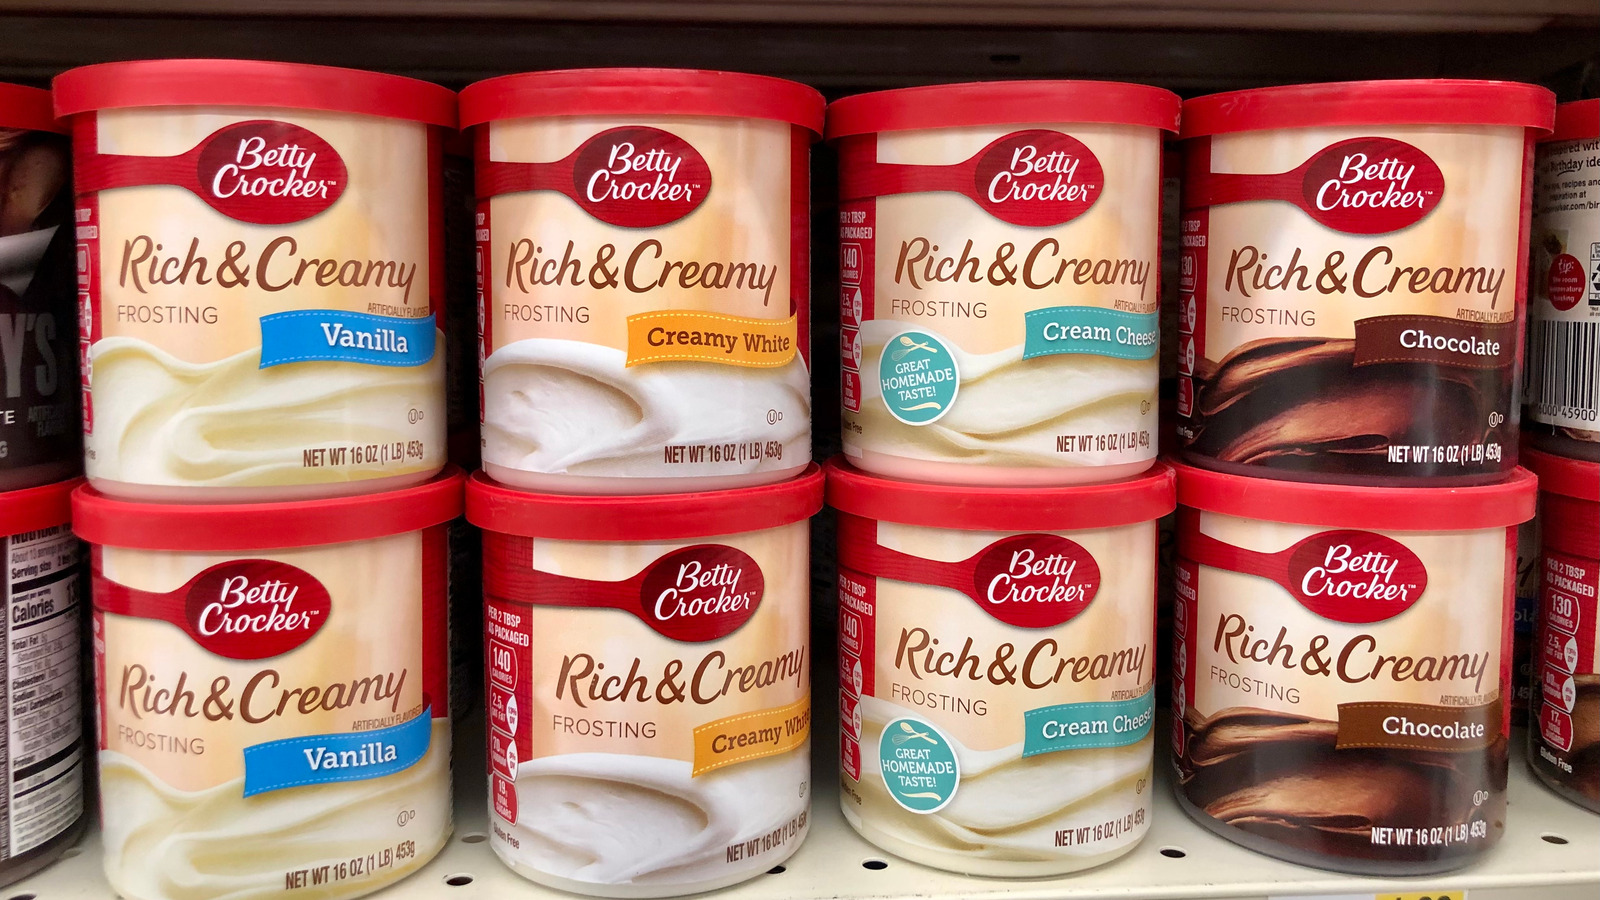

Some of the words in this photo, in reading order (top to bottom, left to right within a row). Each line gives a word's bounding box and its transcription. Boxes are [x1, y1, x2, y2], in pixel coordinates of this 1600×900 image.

[236, 136, 316, 178] Betty
[608, 142, 681, 182] Betty
[1010, 145, 1079, 183] Betty
[1339, 153, 1415, 190] Betty
[851, 211, 866, 224] TBSP
[845, 228, 872, 239] PACKAGED
[843, 249, 857, 268] 140
[1558, 259, 1574, 274] tip:
[118, 305, 218, 323] FROSTING
[367, 302, 406, 317] ARTIFICIALLY
[504, 304, 590, 323] FROSTING
[891, 299, 987, 318] FROSTING
[1221, 306, 1315, 326] FROSTING
[321, 323, 408, 353] Vanilla
[647, 327, 738, 353] Creamy
[743, 333, 790, 353] White
[1043, 322, 1111, 341] Cream
[1116, 326, 1156, 346] Cheese
[1400, 329, 1500, 356] Chocolate
[895, 359, 930, 374] GREAT
[882, 368, 953, 391] HOMEMADE
[898, 386, 936, 401] TASTE!
[1562, 408, 1596, 421] 45900
[304, 449, 325, 467] NET
[330, 448, 346, 466] WT
[350, 447, 362, 464] 16
[365, 445, 378, 462] OZ
[392, 442, 405, 461] LB)
[407, 440, 423, 459] 453g
[664, 446, 685, 463] NET
[689, 445, 705, 463] WT
[709, 445, 720, 462] 16
[724, 444, 736, 461] OZ
[750, 442, 763, 462] LB)
[765, 441, 782, 460] 453g
[1057, 436, 1075, 452] NET
[1079, 435, 1093, 451] WT
[1096, 435, 1105, 450] 16
[1108, 434, 1117, 450] OZ
[1388, 445, 1410, 462] NET
[1413, 446, 1429, 463] WT
[1432, 446, 1444, 463] 16
[1447, 445, 1458, 462] OZ
[1471, 445, 1484, 464] LB)
[1486, 443, 1501, 462] 453g
[12, 564, 38, 580] Serving
[40, 561, 52, 573] size
[1009, 549, 1076, 585] Betty
[1324, 544, 1398, 583] Betty
[1559, 563, 1563, 573] 2
[1565, 564, 1585, 579] TBSP
[676, 561, 741, 593] Betty
[851, 580, 866, 597] TBSP
[1555, 574, 1594, 597] PACKAGED
[221, 575, 298, 612] Betty
[13, 599, 54, 623] Calories
[488, 605, 497, 620] PER
[498, 611, 502, 622] 2
[503, 612, 520, 628] TBSP
[845, 595, 872, 616] PACKAGED
[1552, 594, 1571, 617] 130
[495, 625, 529, 646] PACKAGED
[843, 614, 857, 638] 140
[494, 647, 510, 672] 140
[1211, 665, 1300, 703] FROSTING
[892, 683, 987, 716] FROSTING
[352, 715, 395, 731] ARTIFICIALLY
[553, 715, 656, 738] FROSTING
[1042, 720, 1108, 739] Cream
[1112, 707, 1151, 733] Cheese
[1383, 716, 1484, 739] Chocolate
[119, 724, 205, 755] FROSTING
[712, 726, 782, 753] Creamy
[304, 742, 397, 771] Vanilla
[896, 749, 930, 759] GREAT
[882, 759, 954, 774] HOMEMADE
[898, 775, 937, 787] TASTE!
[1055, 830, 1073, 847] NET
[1077, 828, 1090, 845] WT
[1093, 825, 1102, 841] 16
[1104, 822, 1113, 838] OZ
[1371, 827, 1393, 844] NET
[1396, 828, 1412, 845] WT
[1416, 829, 1427, 845] 16
[1430, 828, 1443, 844] OZ
[1455, 824, 1468, 843] LB)
[1470, 820, 1486, 838] 453g
[727, 843, 744, 863] NET
[747, 840, 759, 857] WT
[762, 836, 770, 852] 16
[772, 829, 781, 847] OZ
[286, 870, 309, 890] NET
[312, 866, 329, 885] WT
[334, 862, 346, 880] 16
[350, 858, 363, 877] OZ
[379, 853, 393, 869] LB)
[396, 840, 415, 860] 453g
